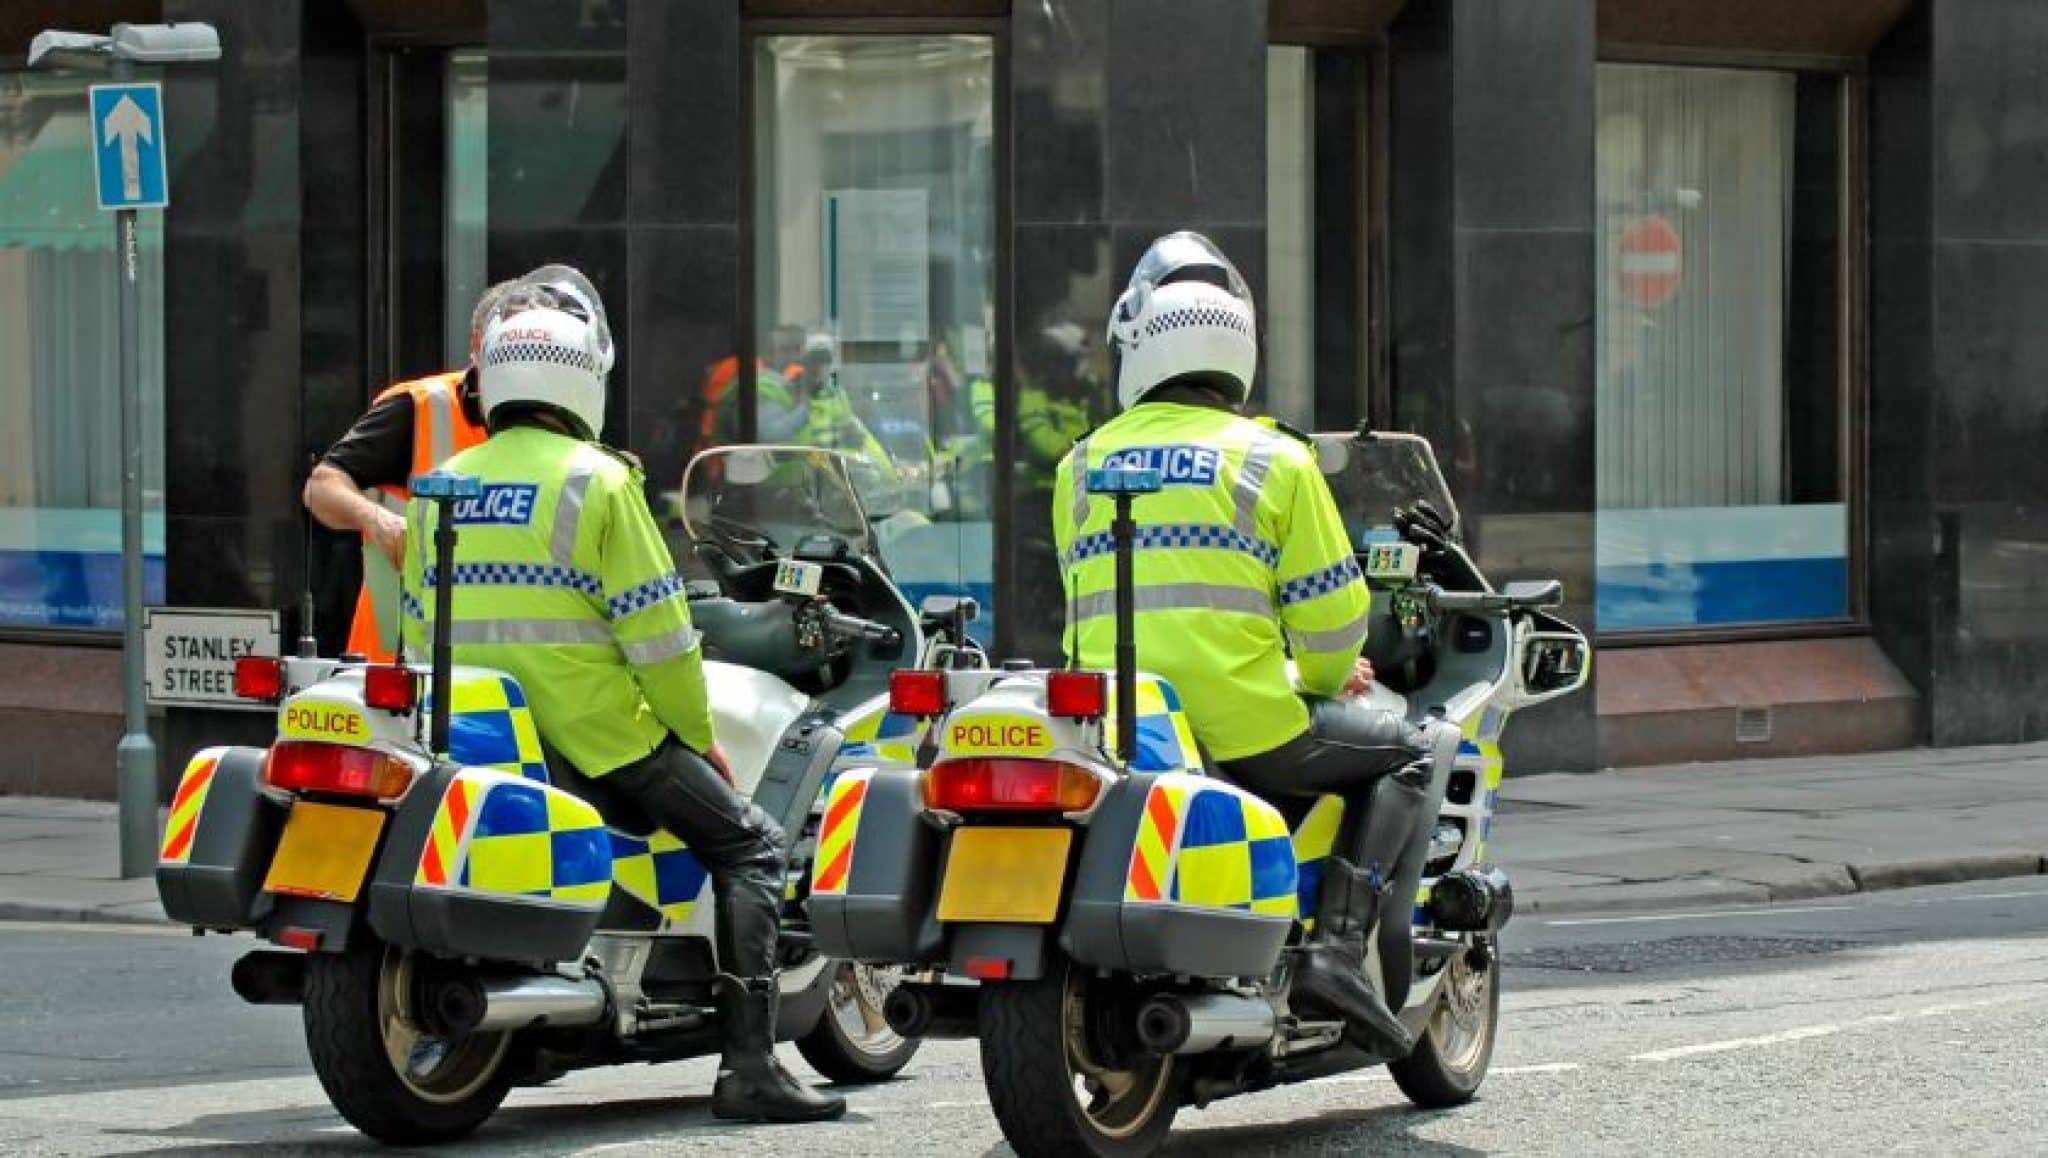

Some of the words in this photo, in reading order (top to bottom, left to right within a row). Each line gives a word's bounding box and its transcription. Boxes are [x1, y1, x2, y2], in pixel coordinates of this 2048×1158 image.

[499, 328, 552, 342] POLICE
[452, 487, 533, 519] OLICE
[165, 635, 256, 661] STANLEY
[287, 708, 361, 735] POLICE
[953, 725, 1044, 747] POLICE
